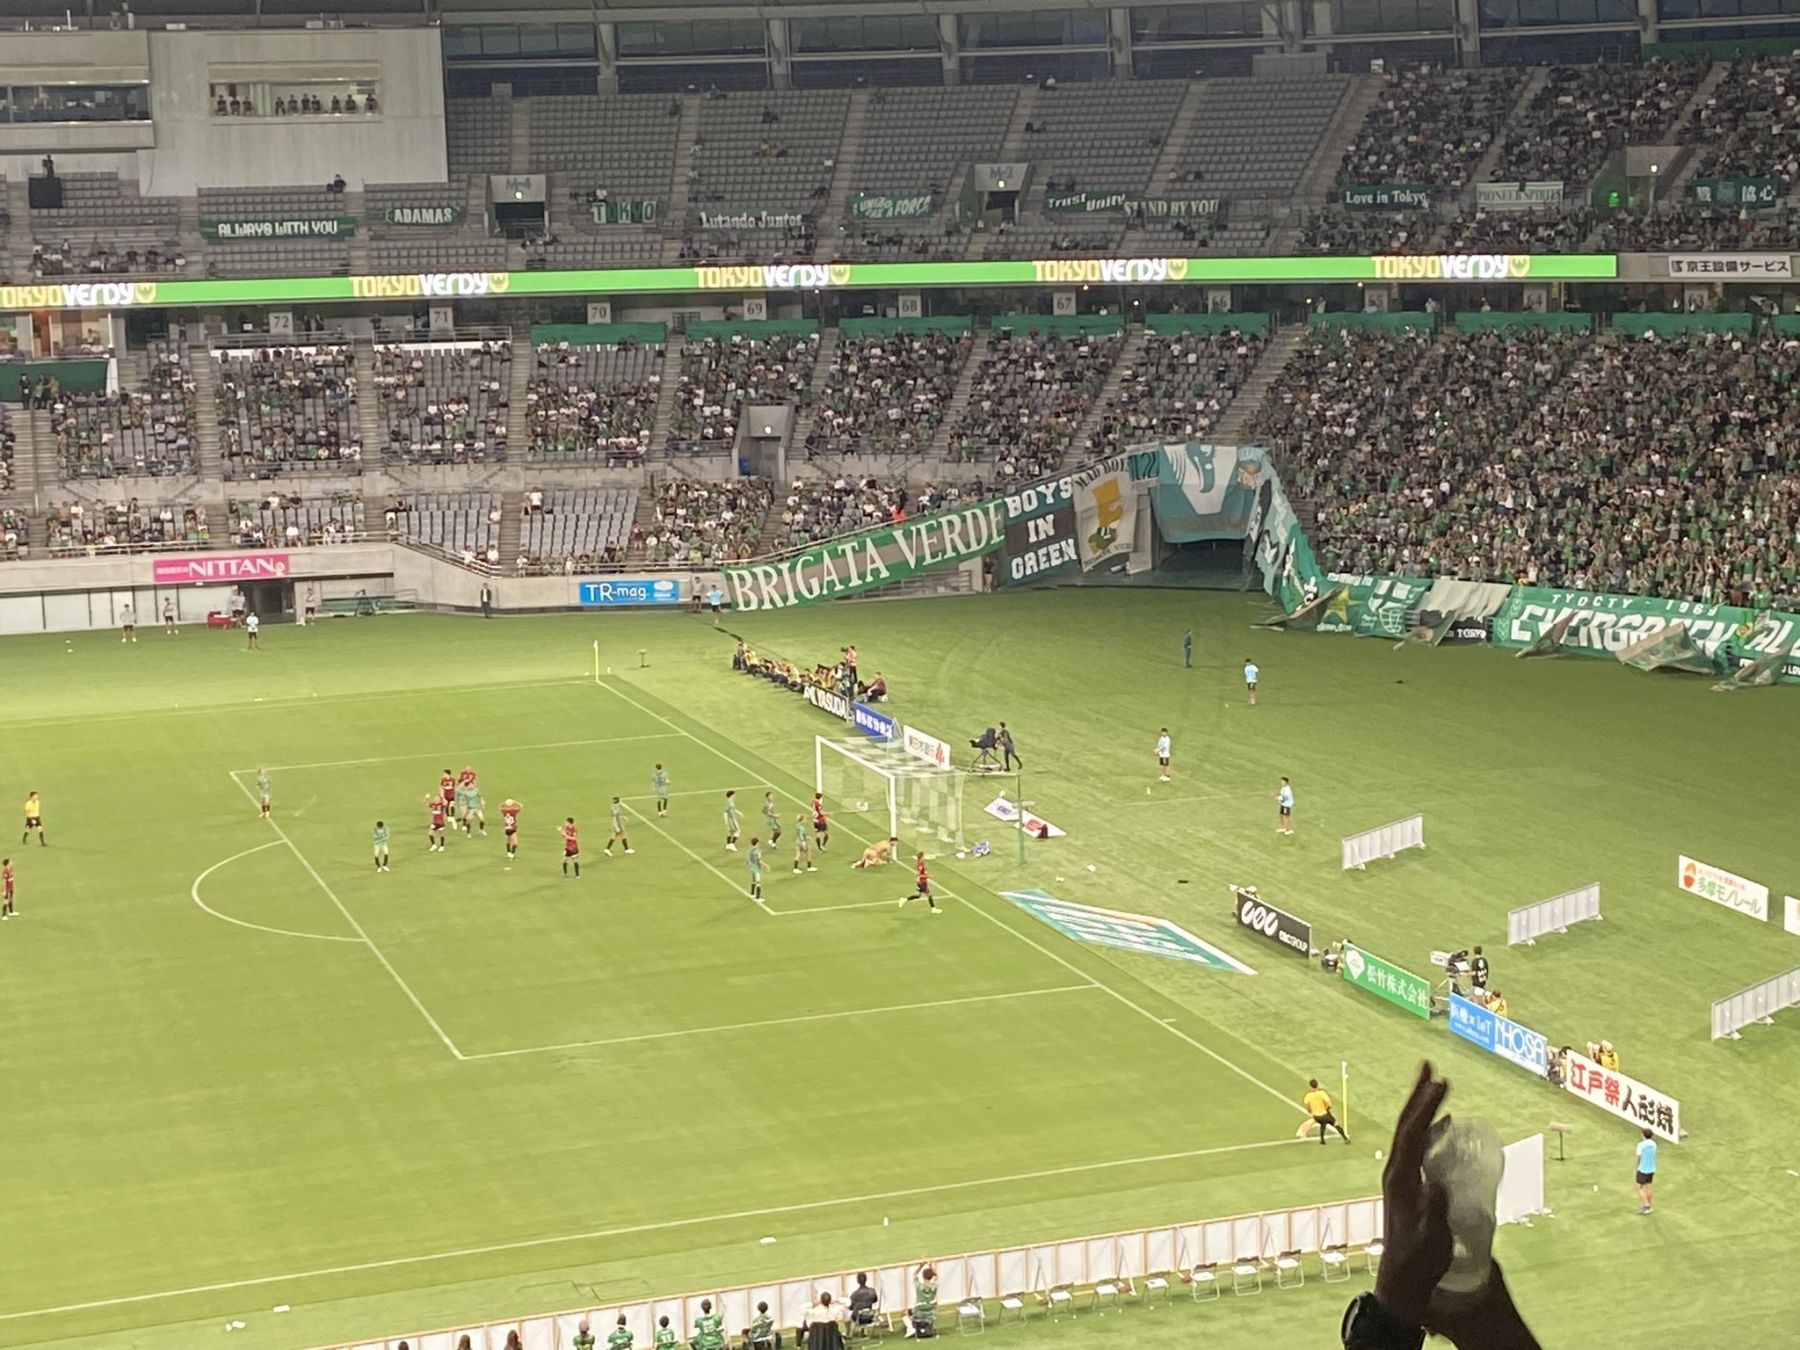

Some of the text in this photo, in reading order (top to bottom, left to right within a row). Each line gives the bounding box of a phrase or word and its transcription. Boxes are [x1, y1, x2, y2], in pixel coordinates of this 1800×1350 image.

[1345, 190, 1374, 204] Love
[1376, 191, 1388, 204] in
[393, 208, 452, 224] ADAMAS
[1170, 201, 1189, 216] BY
[1190, 200, 1219, 216] YOU
[700, 211, 755, 229] Lutando
[217, 220, 338, 238] ALWAYS WITH YOU
[747, 302, 763, 315] 69
[902, 300, 917, 313] 68
[1057, 297, 1073, 310] 67
[433, 310, 449, 323] 71
[591, 306, 607, 318] 70
[273, 315, 289, 328] 72
[1004, 476, 1073, 518] BOYS
[1027, 513, 1056, 543] IN
[1011, 538, 1078, 580] GREEN
[188, 558, 277, 578] NITTAN
[728, 538, 890, 611] BRIGATA
[1551, 593, 1633, 609] TYOCTY
